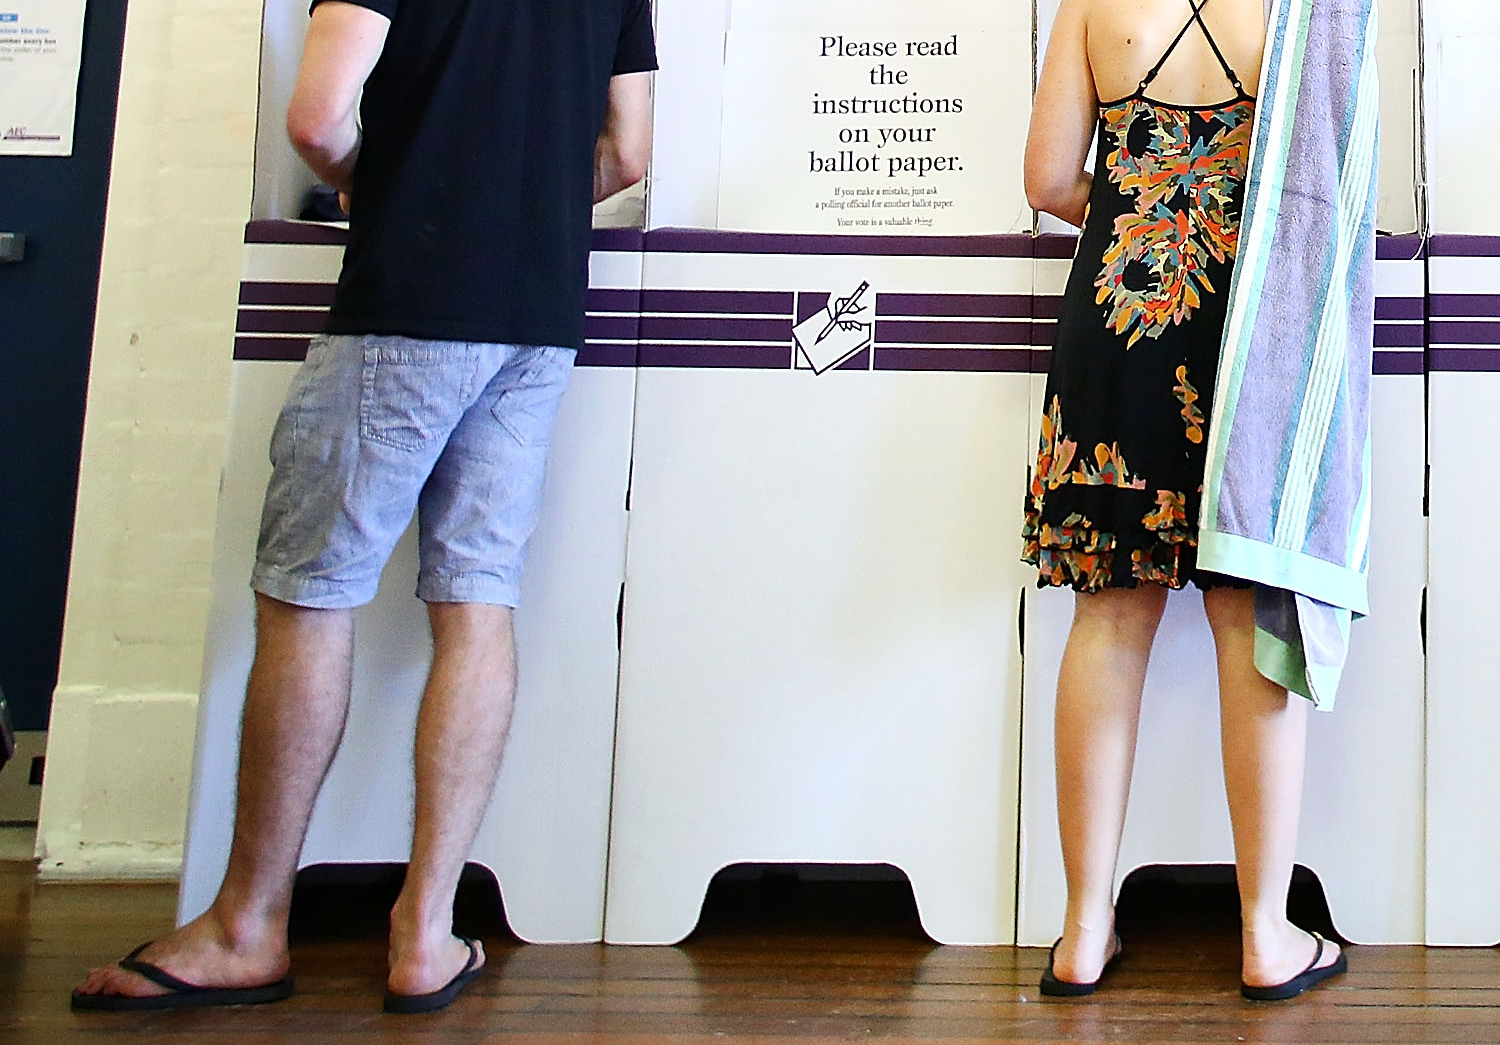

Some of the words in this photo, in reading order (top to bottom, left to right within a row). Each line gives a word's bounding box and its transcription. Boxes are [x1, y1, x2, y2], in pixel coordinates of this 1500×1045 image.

[819, 35, 897, 57] Please
[905, 35, 959, 56] read
[869, 64, 909, 85] the
[812, 92, 963, 114] instructions
[839, 127, 870, 143] on
[877, 127, 936, 148] your
[808, 150, 881, 172] ballot
[888, 156, 964, 177] paper.
[834, 187, 841, 196] If
[841, 188, 854, 198] you
[857, 187, 874, 196] make
[911, 187, 924, 198] just
[926, 186, 938, 195] ask
[821, 199, 845, 210] polling
[846, 199, 870, 208] official
[871, 199, 882, 207] for
[884, 199, 910, 208] another
[912, 198, 931, 207] ballot
[837, 217, 853, 227] Your
[884, 217, 913, 226] valuable
